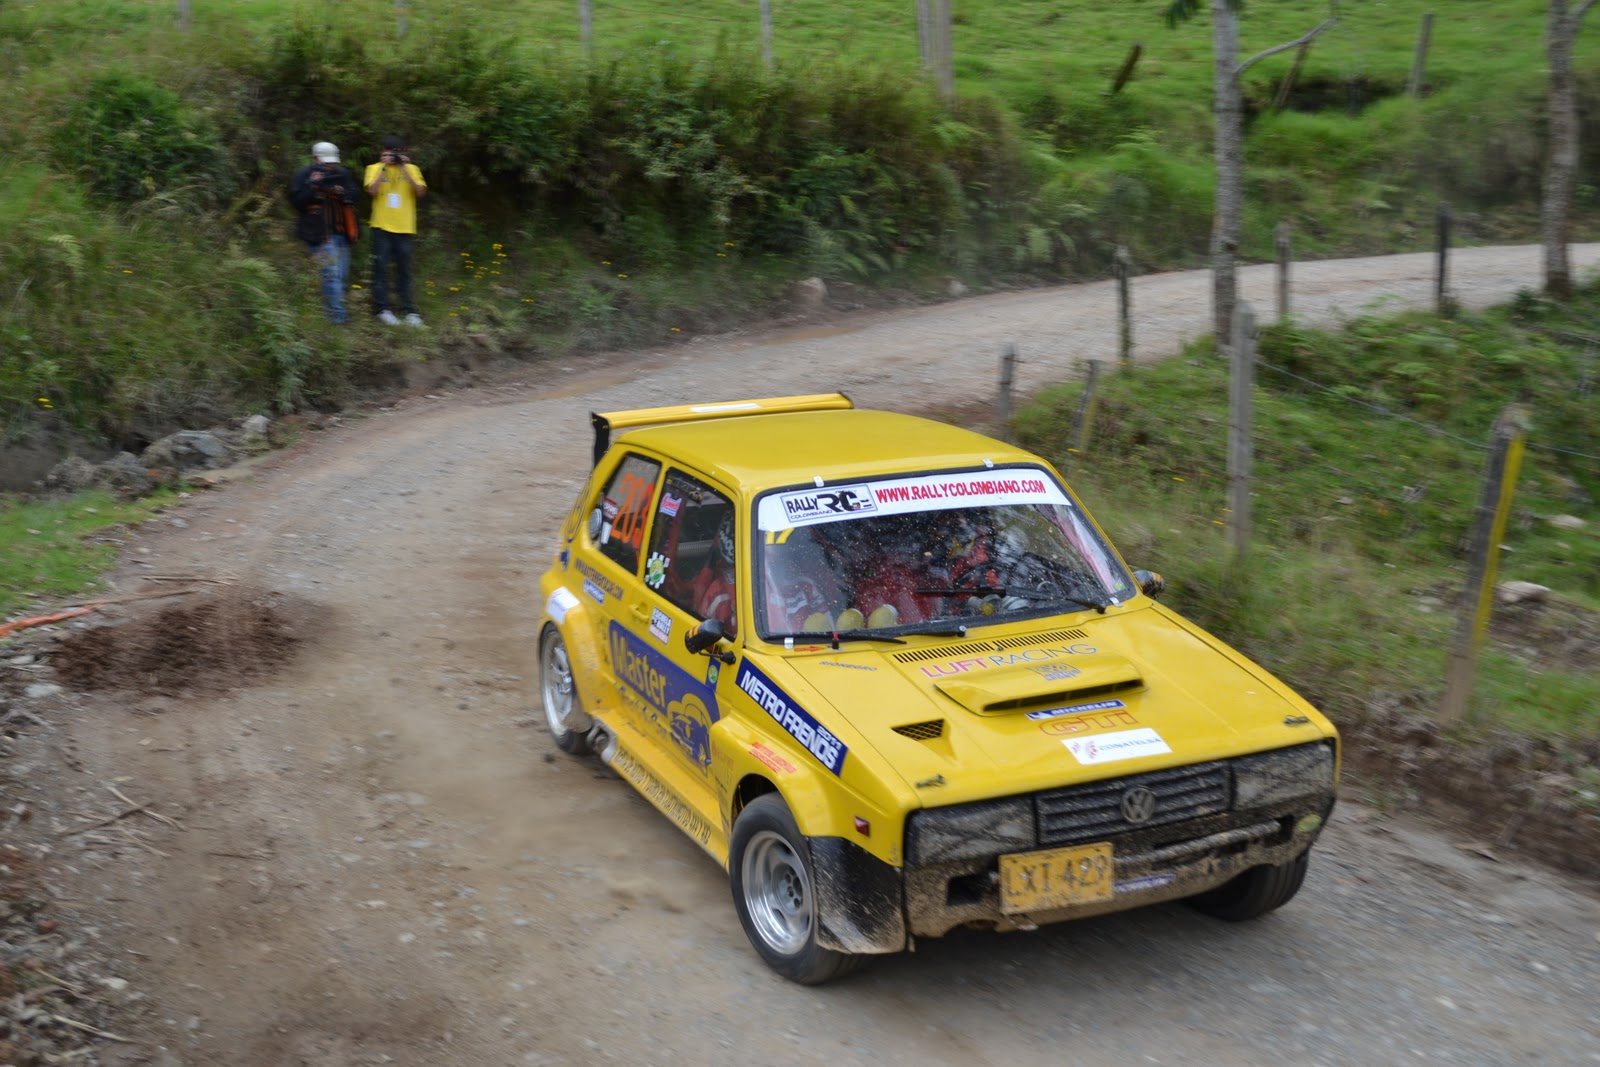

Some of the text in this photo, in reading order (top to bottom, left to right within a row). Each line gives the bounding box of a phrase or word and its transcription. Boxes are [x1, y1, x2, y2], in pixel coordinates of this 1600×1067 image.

[874, 480, 1047, 503] WWW.RALLYCOLOMBIANO.COM
[790, 510, 833, 520] COLOMBIANO
[612, 631, 667, 708] Master
[919, 643, 1098, 679] LUFT RACING
[740, 669, 787, 722] METRO
[782, 707, 840, 770] FRENOS
[1050, 700, 1119, 716] MICHELIN
